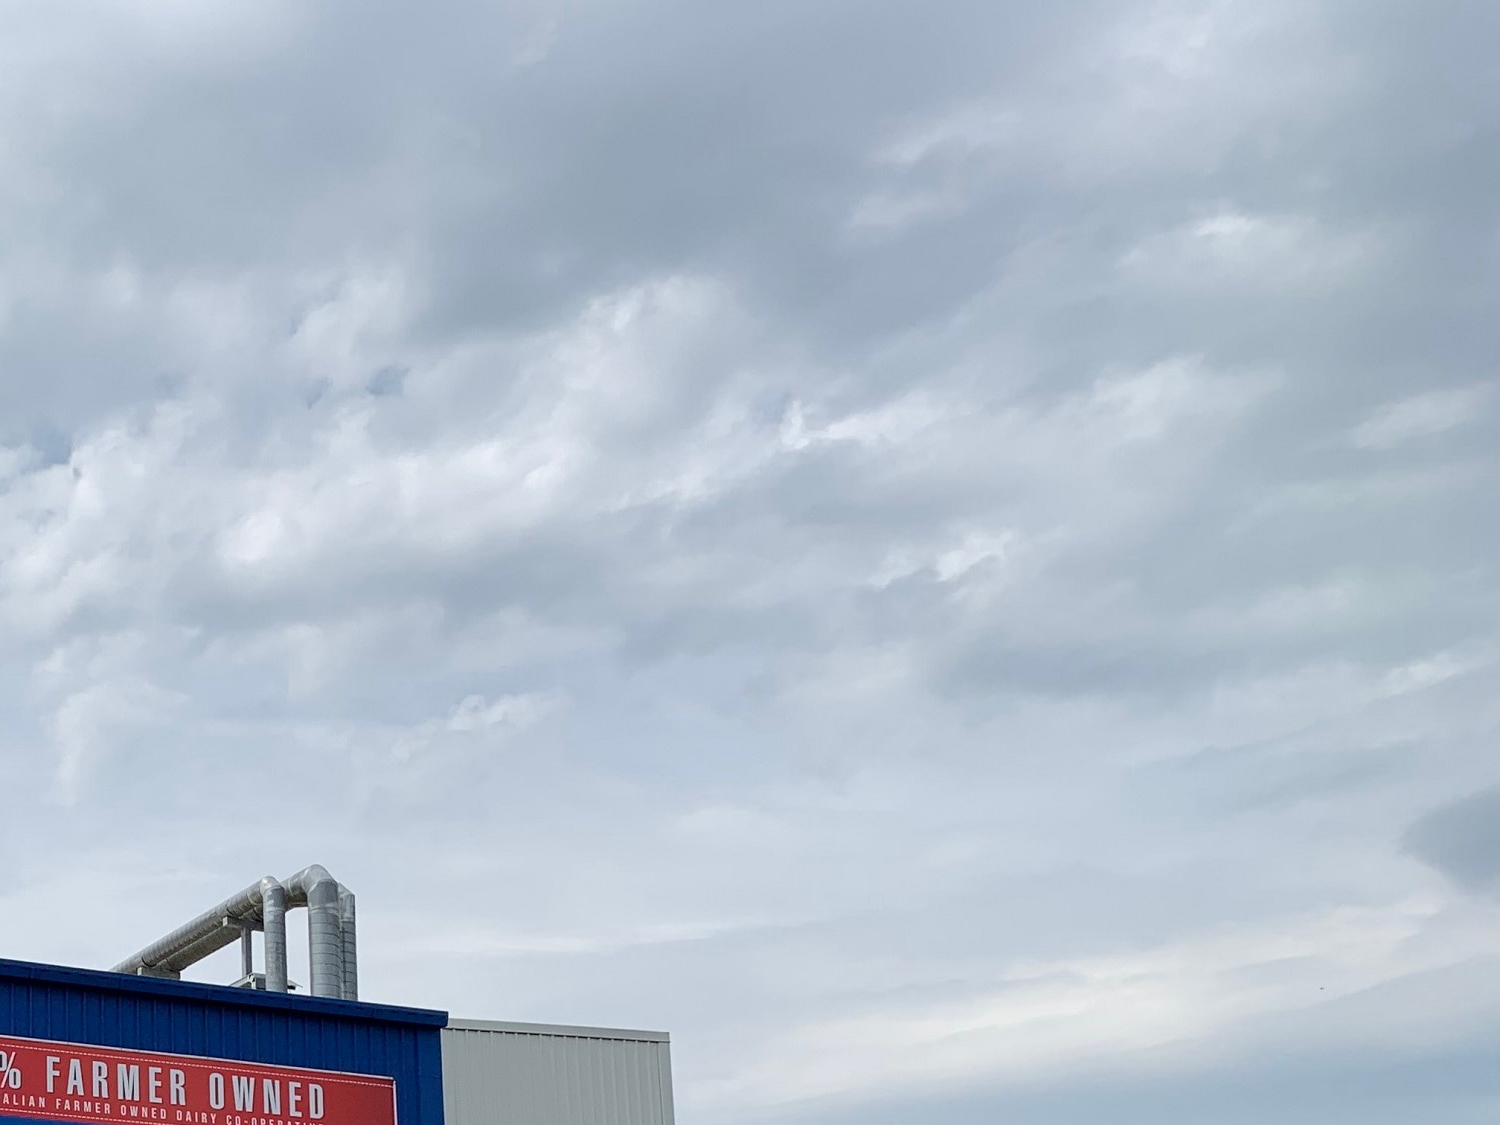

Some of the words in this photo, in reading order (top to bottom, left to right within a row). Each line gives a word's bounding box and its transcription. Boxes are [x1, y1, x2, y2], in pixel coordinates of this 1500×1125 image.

[46, 1055, 187, 1106] FARMER
[208, 1072, 325, 1120] OWNED
[55, 1098, 111, 1115] FARMER
[120, 1104, 167, 1120] OWNED
[176, 1110, 218, 1125] DAIRY
